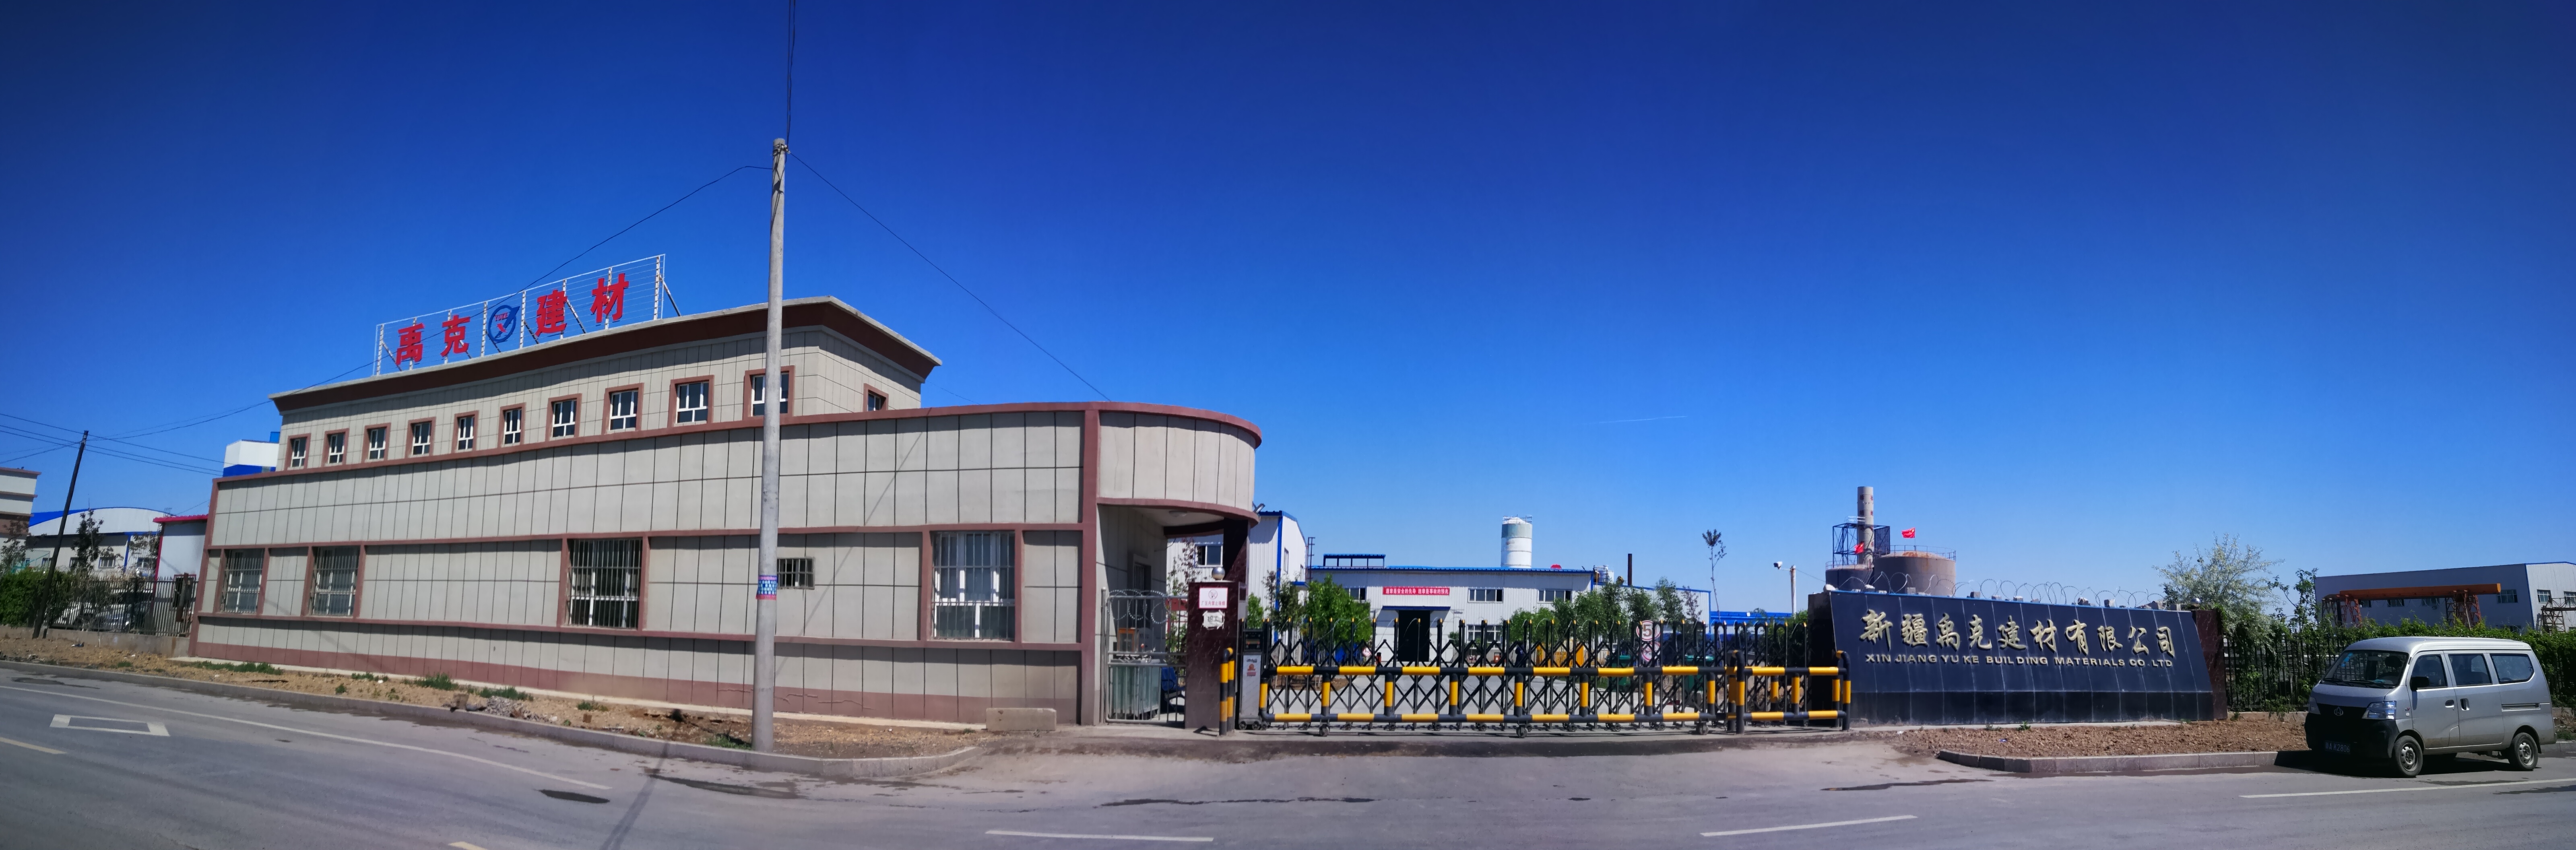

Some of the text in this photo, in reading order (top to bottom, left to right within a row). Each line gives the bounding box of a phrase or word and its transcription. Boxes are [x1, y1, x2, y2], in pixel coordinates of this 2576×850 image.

[396, 273, 629, 365] 禹克 建材
[1643, 624, 1652, 637] 5
[1859, 609, 2175, 658] 新疆禹克建材有限公司
[2054, 657, 2125, 667] MATERIALS
